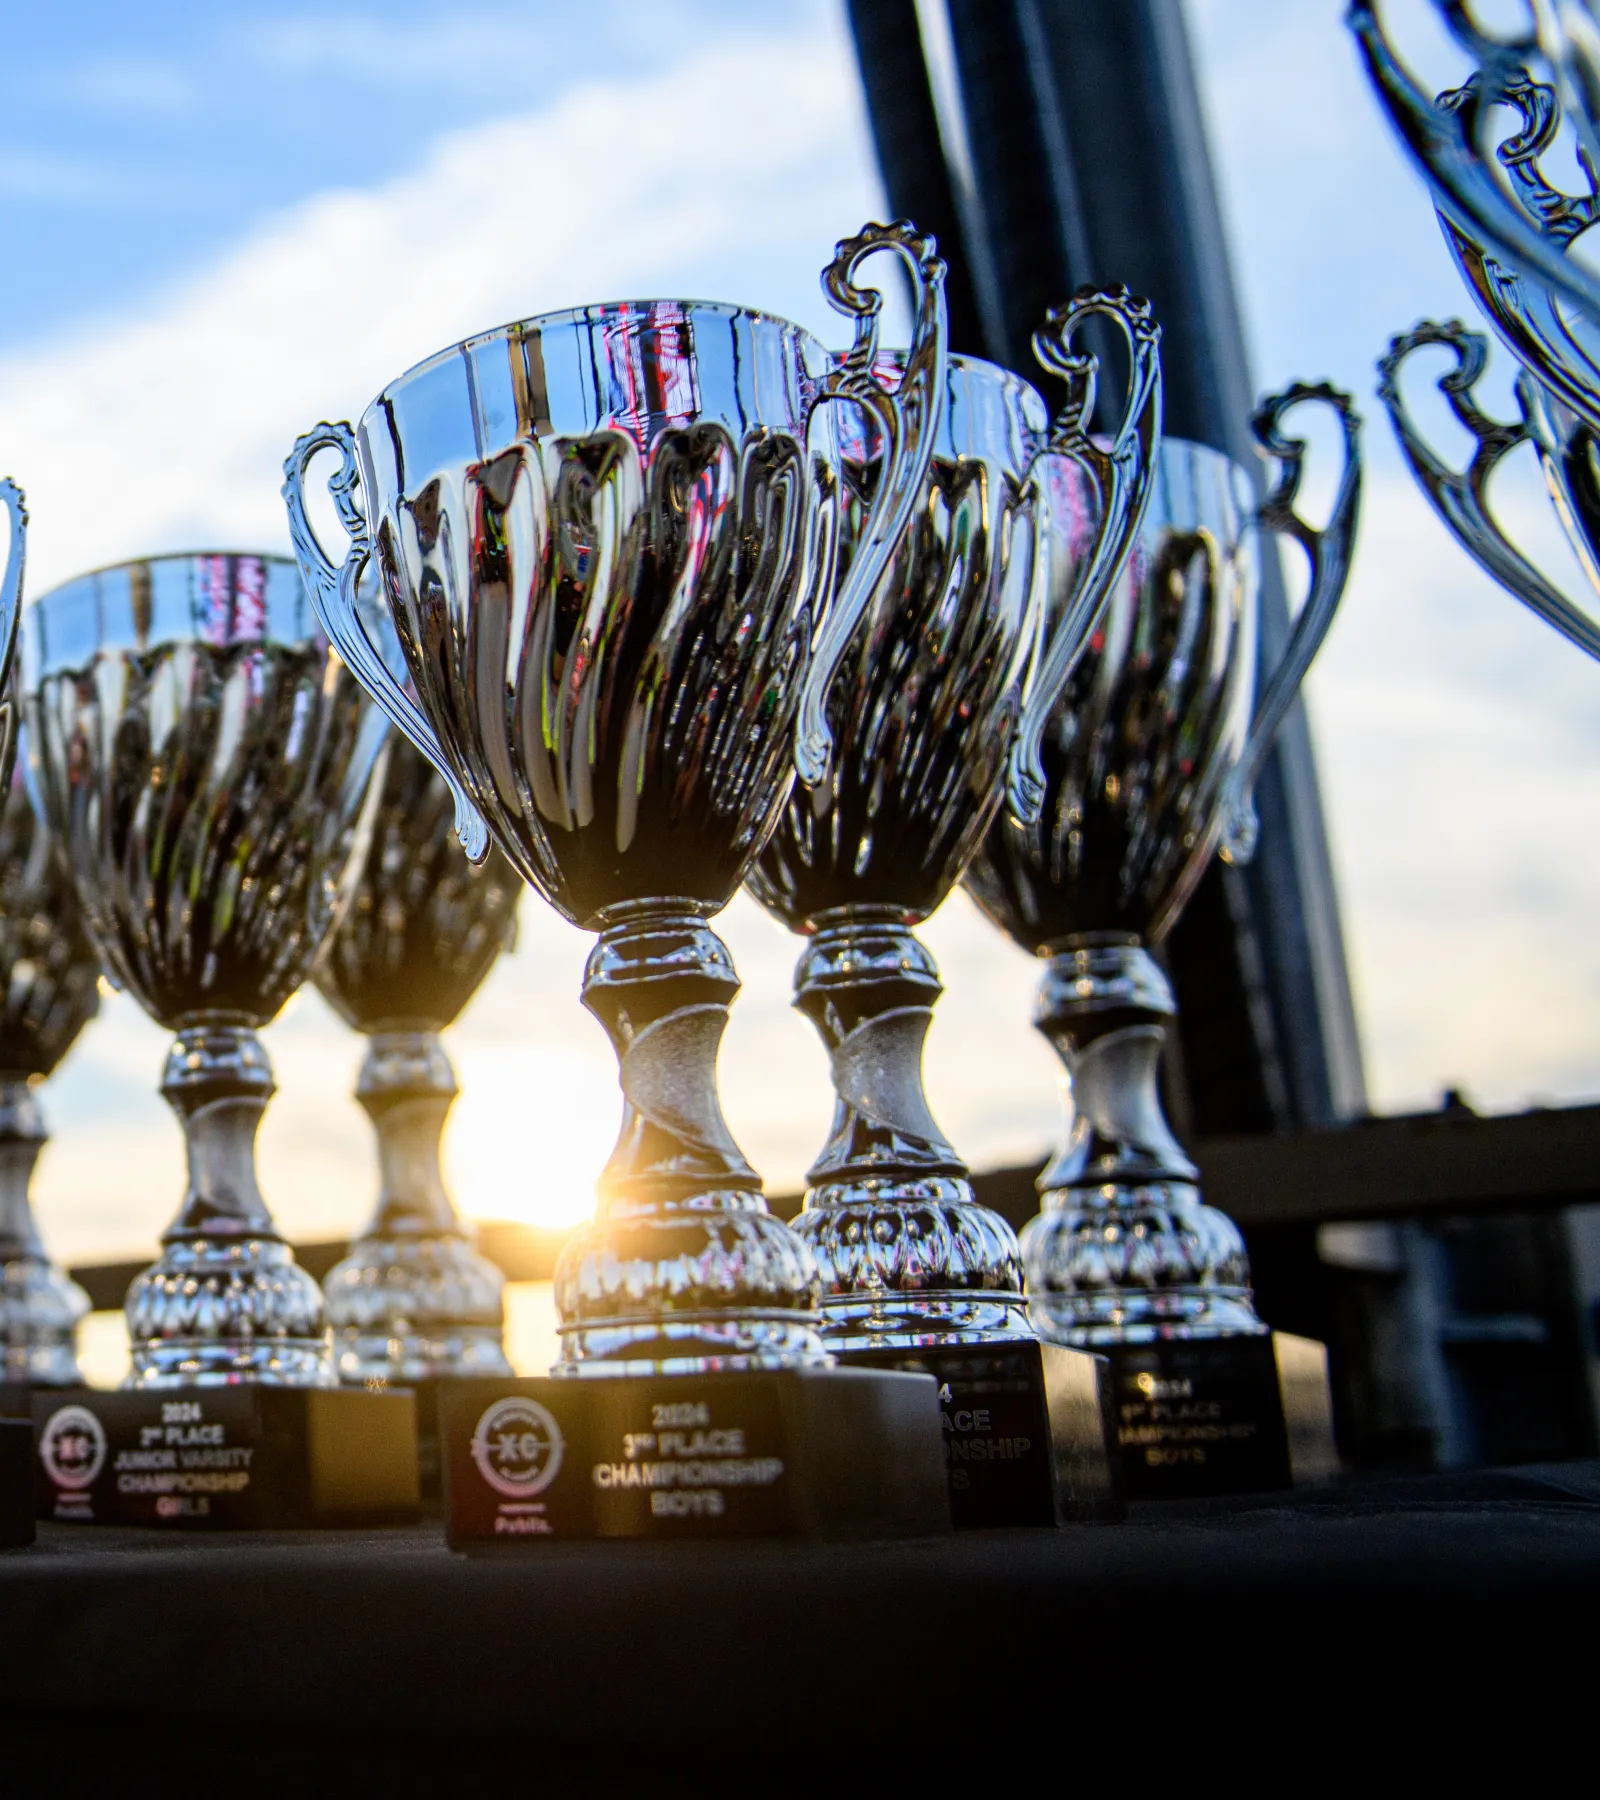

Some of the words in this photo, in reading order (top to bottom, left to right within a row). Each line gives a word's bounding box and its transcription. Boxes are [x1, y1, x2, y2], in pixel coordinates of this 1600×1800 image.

[652, 1402, 710, 1428] 2024
[1149, 1401, 1222, 1423] PLACE
[165, 1424, 225, 1446] PLACE
[658, 1428, 746, 1457] PLACE
[113, 1449, 178, 1471] JUNIOR
[180, 1446, 254, 1469] VARSITY
[1144, 1445, 1207, 1466] BOYS
[117, 1472, 250, 1494] CHAMPIONSHIP
[593, 1457, 785, 1489] CHAMPIONSHIP
[651, 1489, 725, 1516] BOYS
